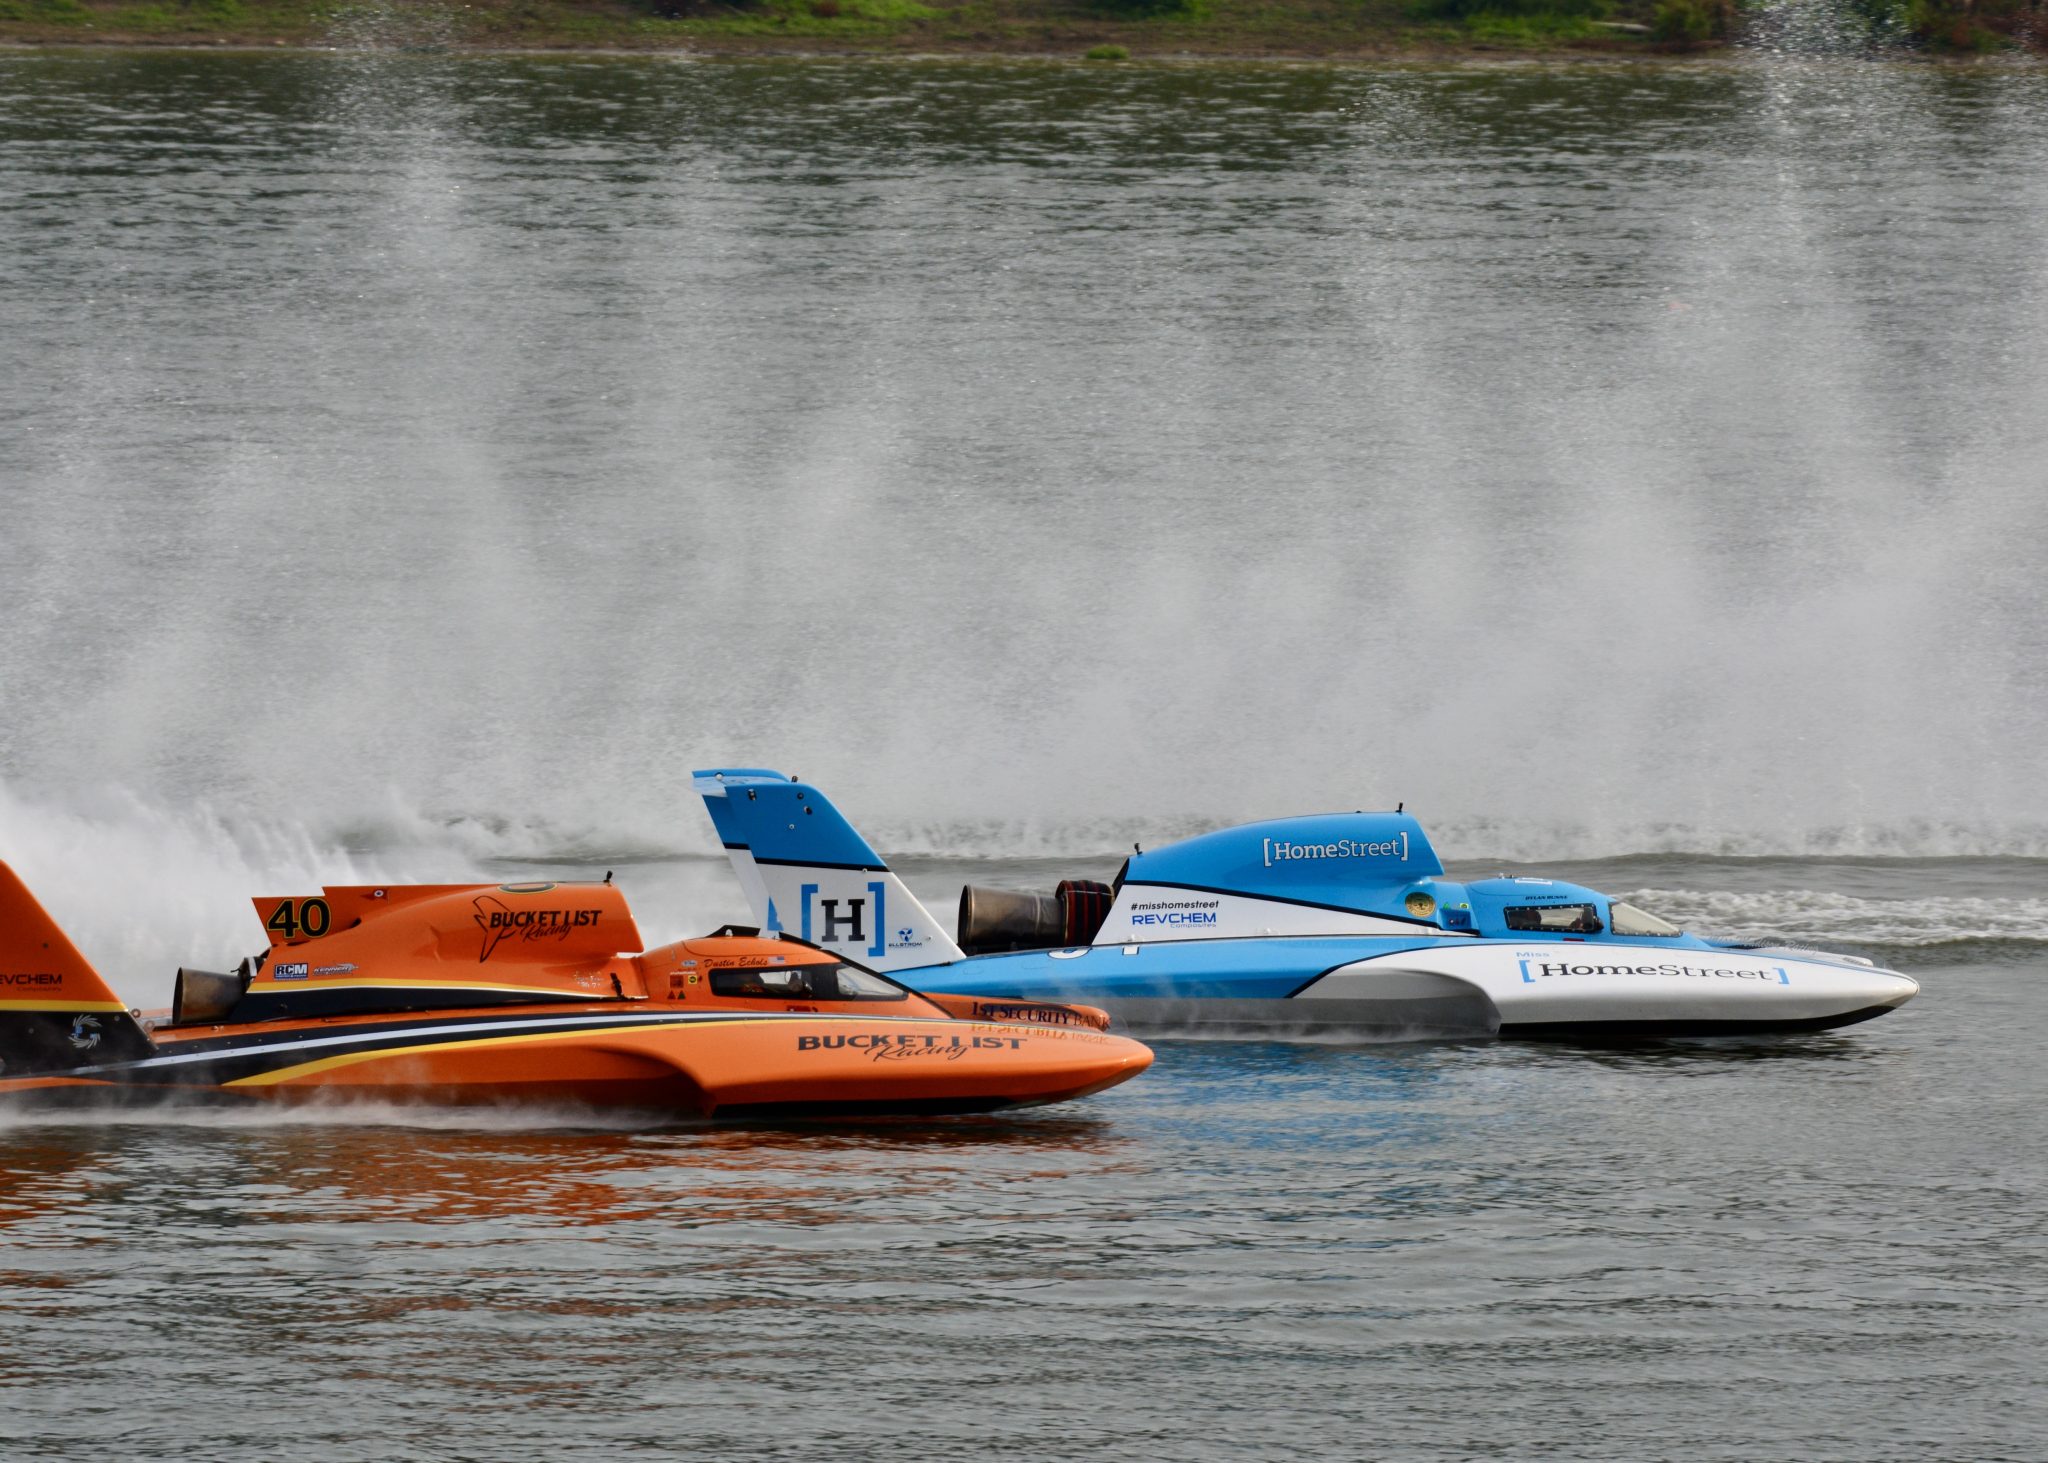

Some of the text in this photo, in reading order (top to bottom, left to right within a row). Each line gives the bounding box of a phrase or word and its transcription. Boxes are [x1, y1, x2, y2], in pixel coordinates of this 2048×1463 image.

[1131, 900, 1219, 911] #misshomestreet
[266, 897, 331, 939] 40
[490, 909, 602, 928] BUCKET LIST
[1132, 912, 1217, 925] REVCHEM
[276, 963, 308, 976] RCM
[703, 957, 736, 968] Dustin
[738, 955, 769, 967] Echols
[972, 1001, 1112, 1031] 1ST SECURITY BANK
[797, 1035, 1027, 1051] BUCKET LIST
[863, 1043, 969, 1062] Racing
